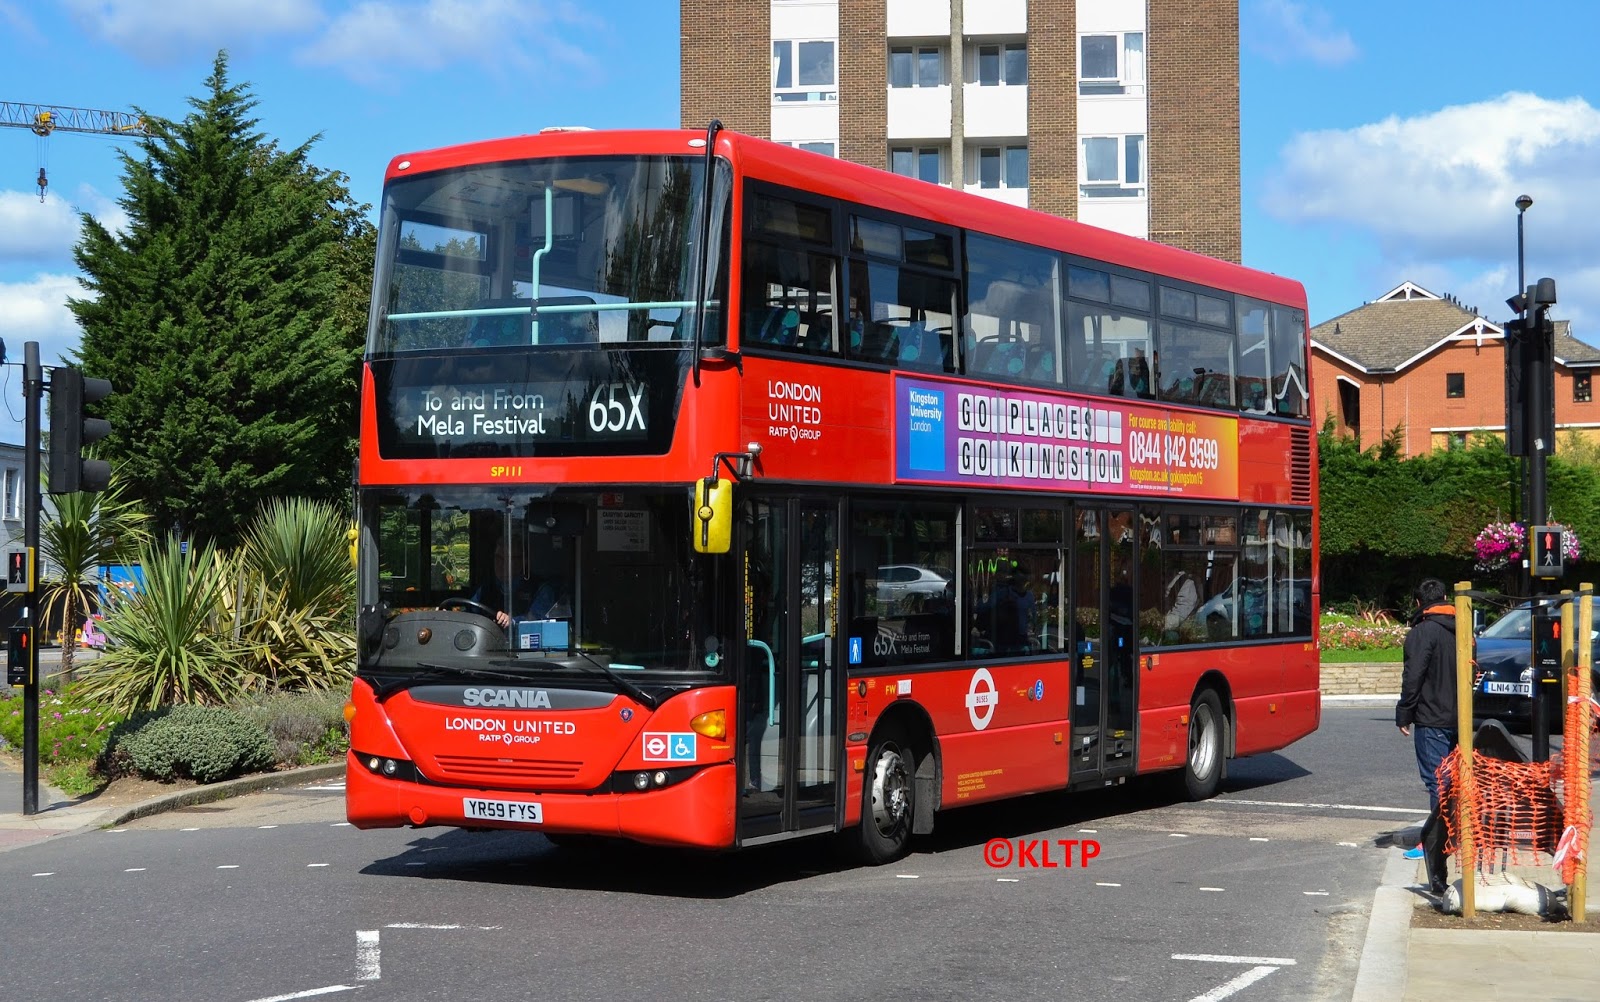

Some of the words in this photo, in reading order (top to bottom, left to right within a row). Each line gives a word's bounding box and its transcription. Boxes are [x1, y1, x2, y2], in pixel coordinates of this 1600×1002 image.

[421, 390, 442, 412] To
[451, 389, 485, 411] and
[494, 389, 544, 410] From
[768, 380, 821, 402] LONDON
[909, 391, 939, 406] Kingston
[588, 382, 646, 433] 65X
[768, 403, 821, 424] UNITED
[910, 405, 942, 422] University
[962, 397, 987, 427] GO
[1011, 403, 1092, 437] PLACES
[417, 414, 464, 436] Mela
[473, 412, 546, 436] Festival
[769, 426, 788, 437] RATP
[799, 429, 821, 440] GROUP
[910, 419, 932, 432] London
[1128, 413, 1139, 428] For
[1139, 417, 1157, 430] course
[1157, 417, 1186, 435] avalability
[1186, 420, 1197, 434] call:
[962, 441, 987, 471] GO
[1011, 445, 1120, 479] KINGSTON
[1129, 430, 1161, 465] 0844
[1164, 434, 1187, 467] 842
[1189, 437, 1218, 470] 9599
[873, 632, 898, 656] 65X
[463, 688, 552, 709] SCANIA
[886, 684, 897, 695] FW
[1491, 683, 1510, 693] LN14
[1512, 684, 1530, 693] XTD
[976, 695, 989, 703] BUSES
[445, 717, 506, 731] LONDON
[513, 720, 576, 735] UNITED
[479, 733, 501, 742] RATP
[514, 736, 540, 744] GROUP
[469, 800, 505, 818] YR59
[508, 802, 537, 820] FYS
